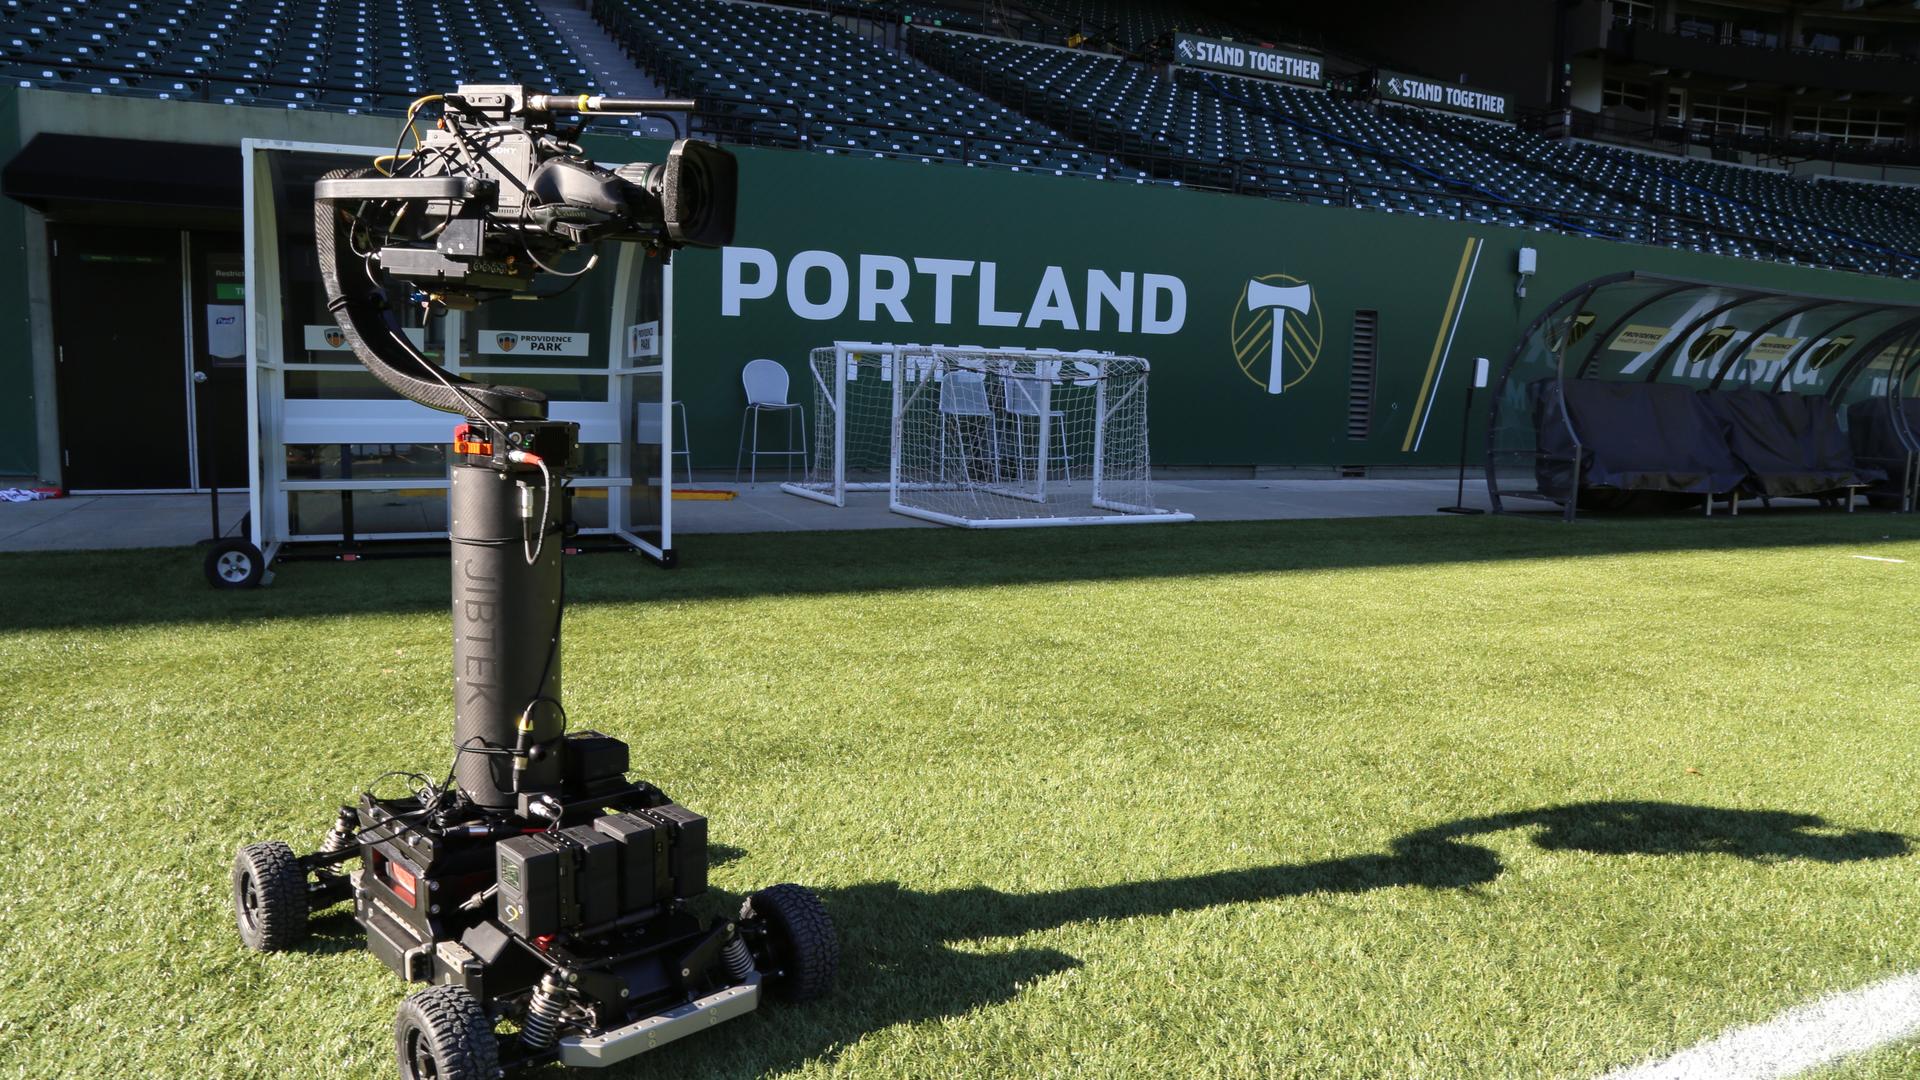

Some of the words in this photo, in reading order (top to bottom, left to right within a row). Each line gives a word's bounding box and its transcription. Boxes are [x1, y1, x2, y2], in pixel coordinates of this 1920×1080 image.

[1196, 42, 1244, 67] STAND
[1249, 51, 1320, 80] TOGETHER
[1402, 80, 1442, 103] STAND
[1446, 87, 1505, 114] TOGETHER
[721, 246, 1188, 335] PORTLAND
[520, 335, 573, 343] PROVIDENCE
[530, 342, 562, 352] PARK
[465, 558, 498, 705] JIBTEK
